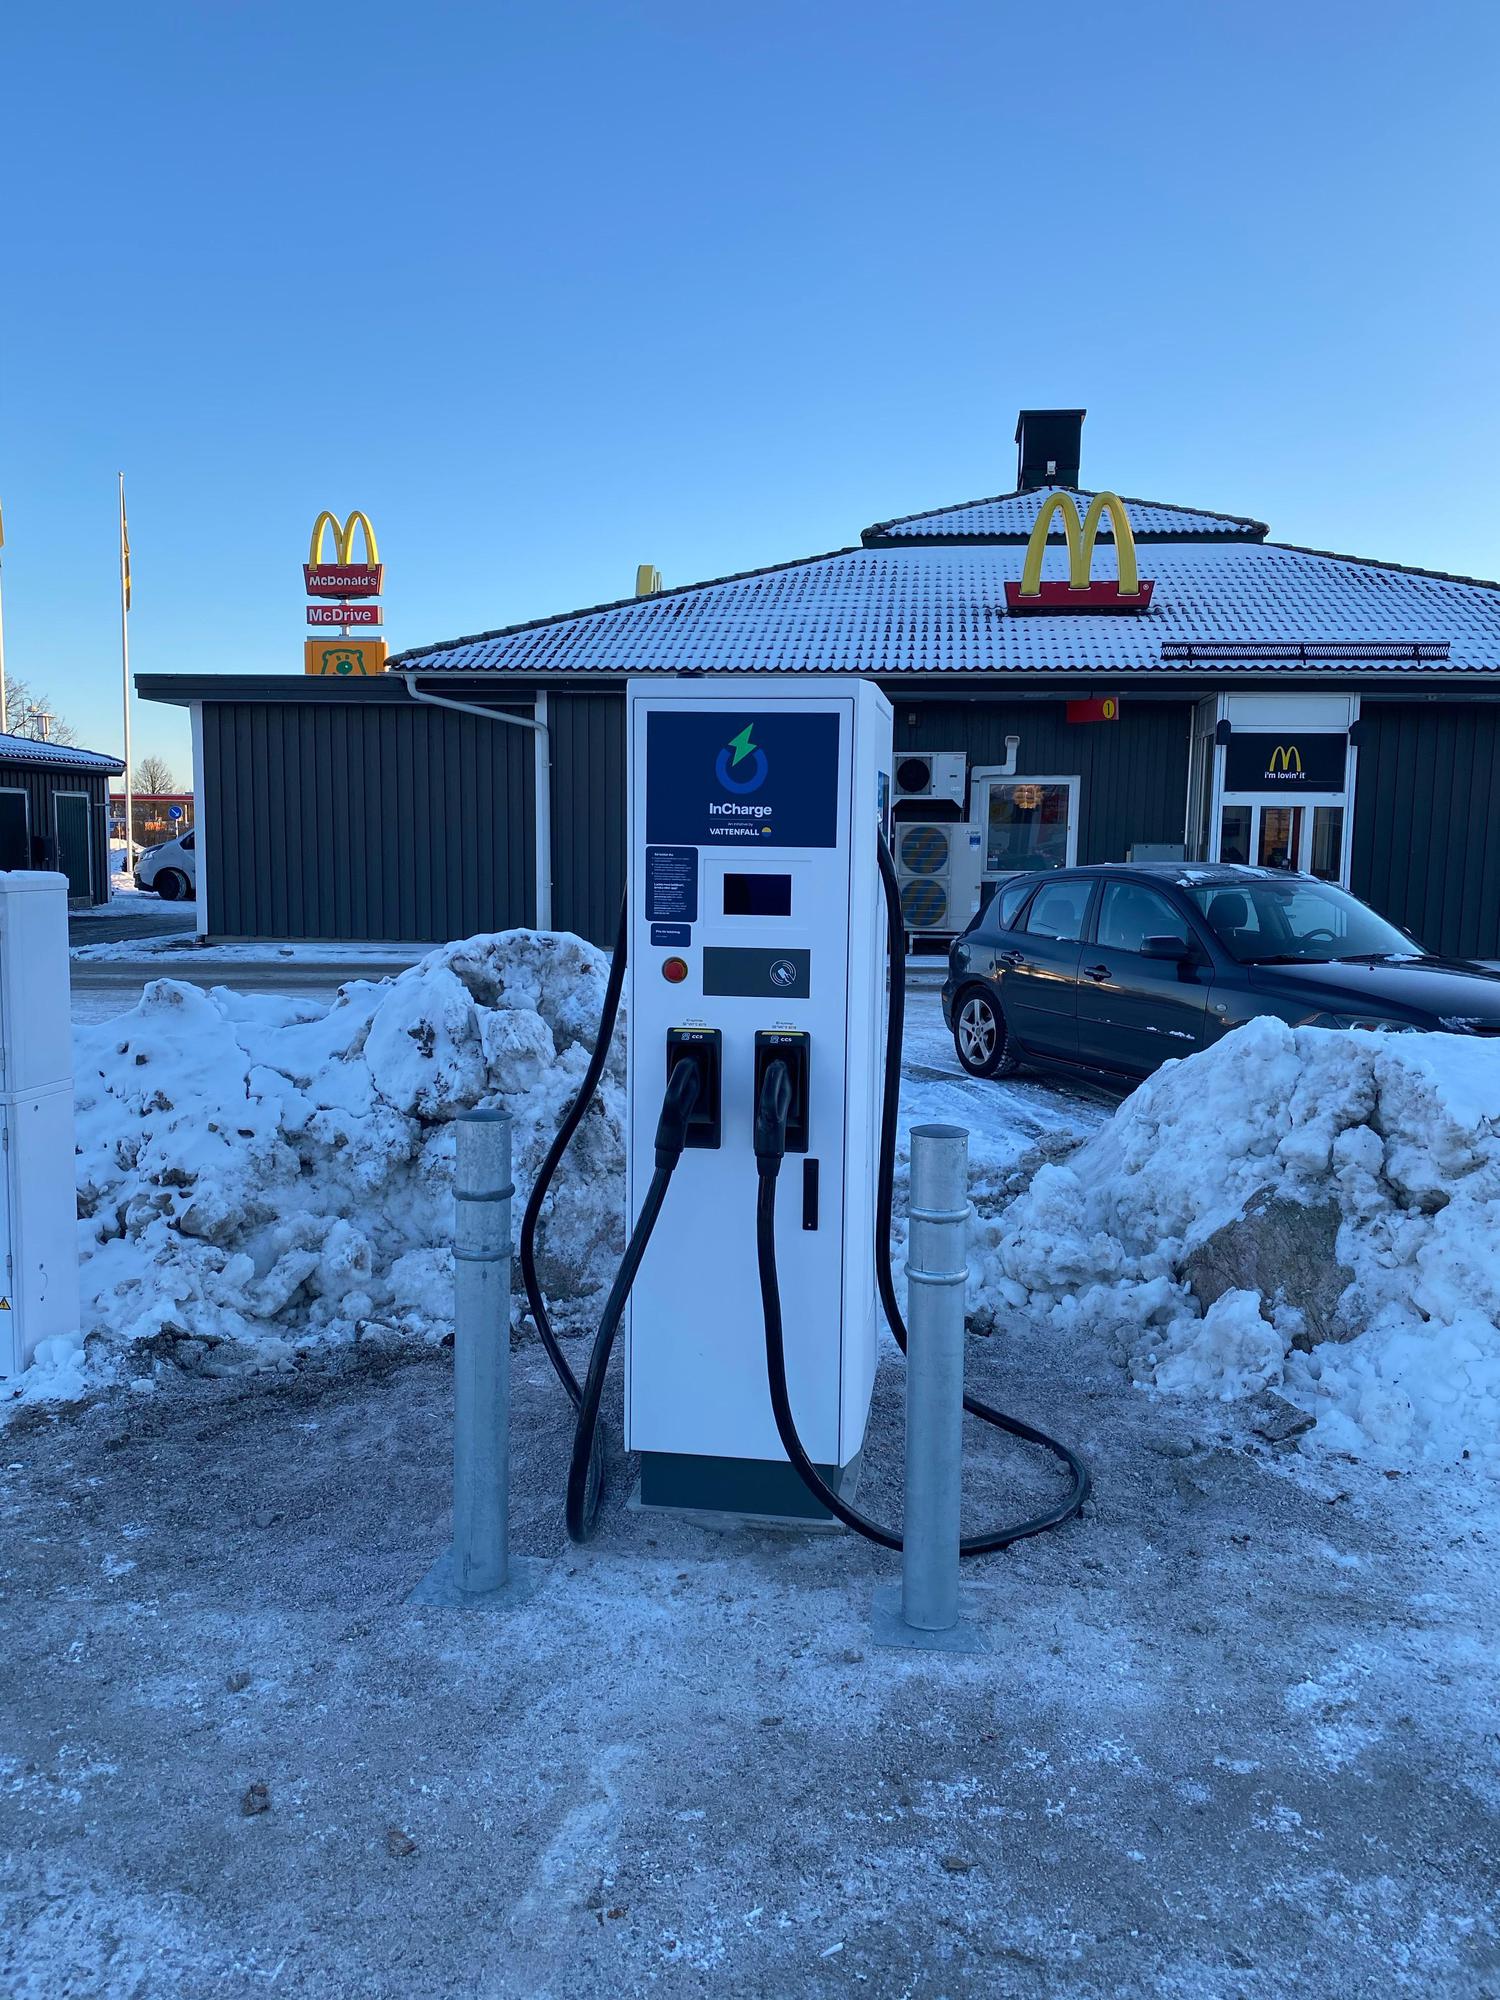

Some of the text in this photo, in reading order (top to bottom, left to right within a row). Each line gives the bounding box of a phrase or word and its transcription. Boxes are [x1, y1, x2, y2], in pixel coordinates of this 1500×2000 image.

[309, 576, 377, 586] McDonald's
[309, 608, 371, 621] McDrive
[1264, 771, 1305, 779] i'm lovin' it
[709, 803, 772, 818] InCharge
[709, 828, 760, 836] VATTENFALL
